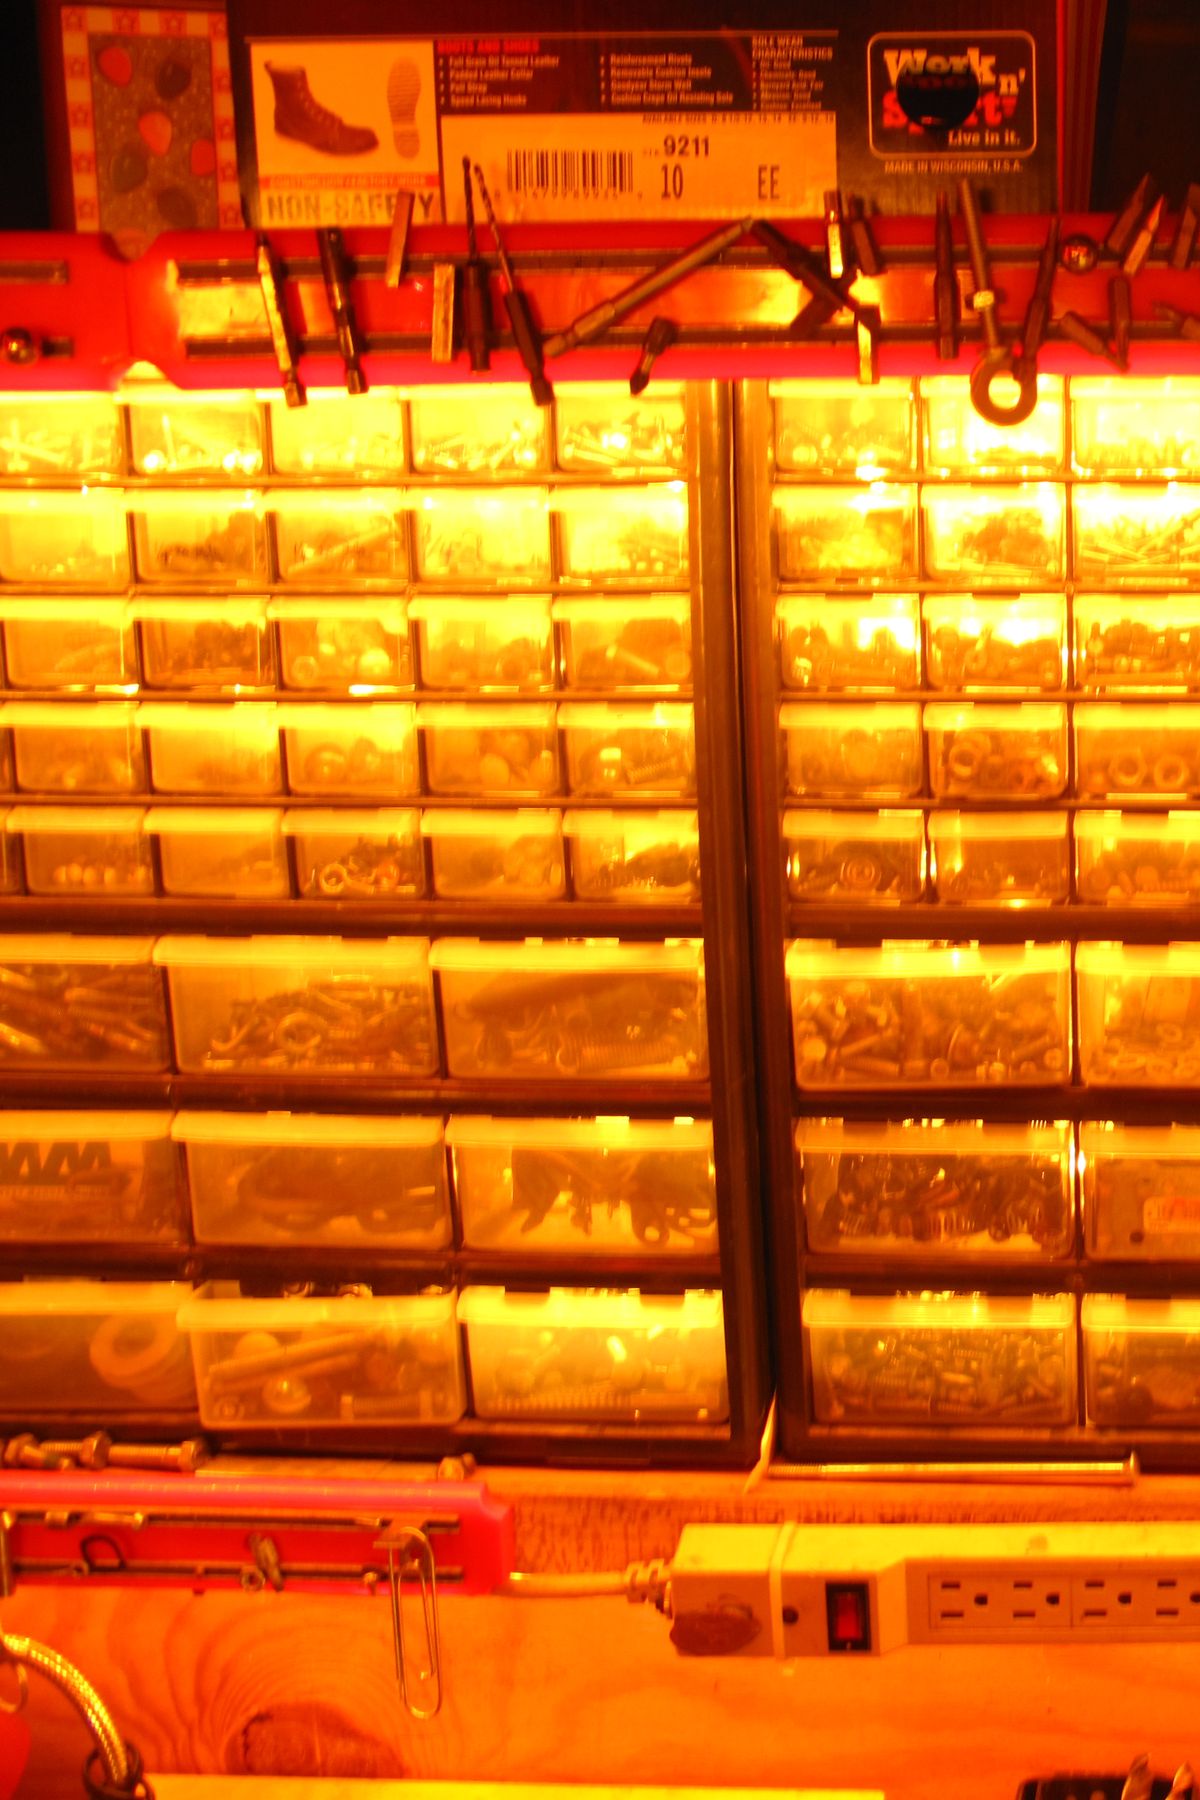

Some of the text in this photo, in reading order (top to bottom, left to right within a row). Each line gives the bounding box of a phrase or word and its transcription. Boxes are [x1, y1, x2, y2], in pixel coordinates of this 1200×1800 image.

[530, 54, 560, 67] Leather
[752, 47, 833, 60] CHARACTERISTICS
[884, 47, 996, 86] Work
[663, 135, 710, 158] 9211
[948, 130, 980, 146] Live
[985, 129, 999, 145] in
[884, 160, 913, 174] MADE
[917, 160, 928, 173] IN
[661, 164, 683, 200] 10
[758, 164, 780, 200] EE
[267, 191, 434, 222] NON-SAFEY
